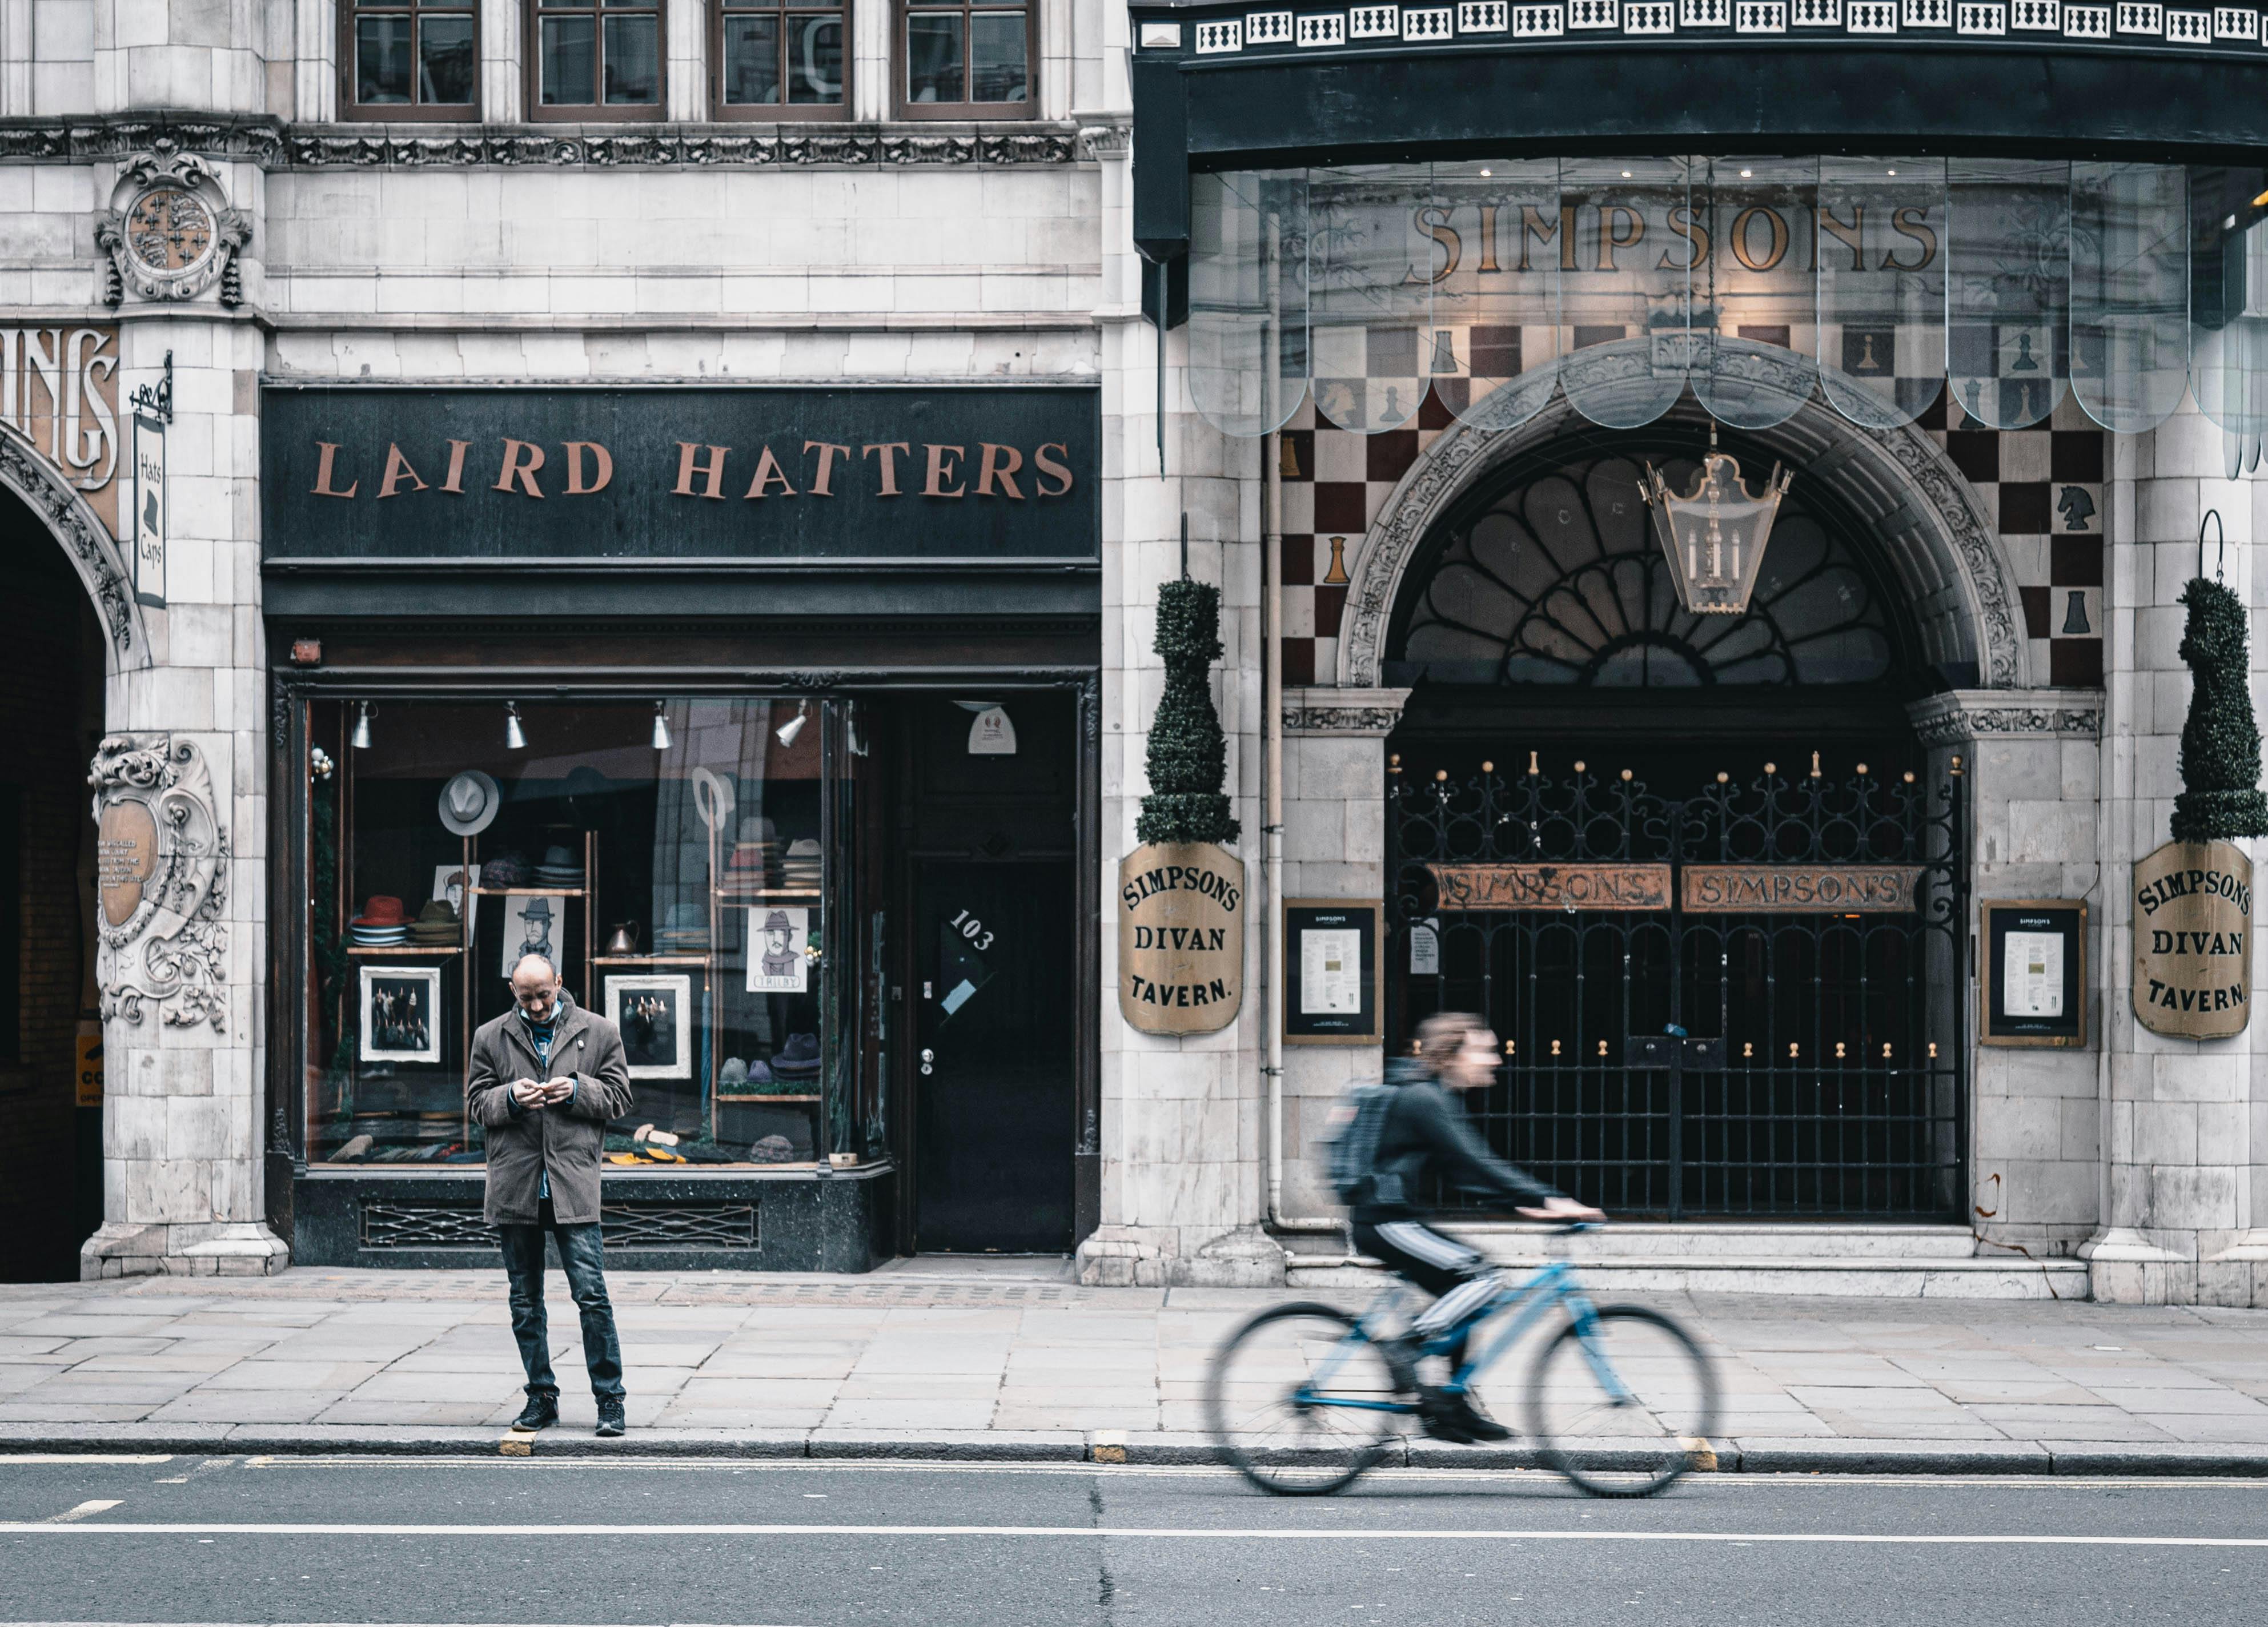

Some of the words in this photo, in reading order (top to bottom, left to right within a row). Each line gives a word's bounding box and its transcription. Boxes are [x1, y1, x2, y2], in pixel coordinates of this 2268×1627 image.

[1399, 204, 1938, 286] SIMPSONS
[141, 452, 160, 484] Hats
[310, 437, 614, 499] LAIRD
[671, 440, 1074, 499] HATTERS
[141, 533, 161, 569] Caps
[1701, 874, 1900, 903] SIMPSON'S
[950, 909, 994, 950] 103
[1135, 926, 1225, 951] DIVAN
[2151, 930, 2242, 955] DIVAN
[1132, 975, 1231, 1007] TAVERN.
[2149, 978, 2247, 1012] TAVERN.
